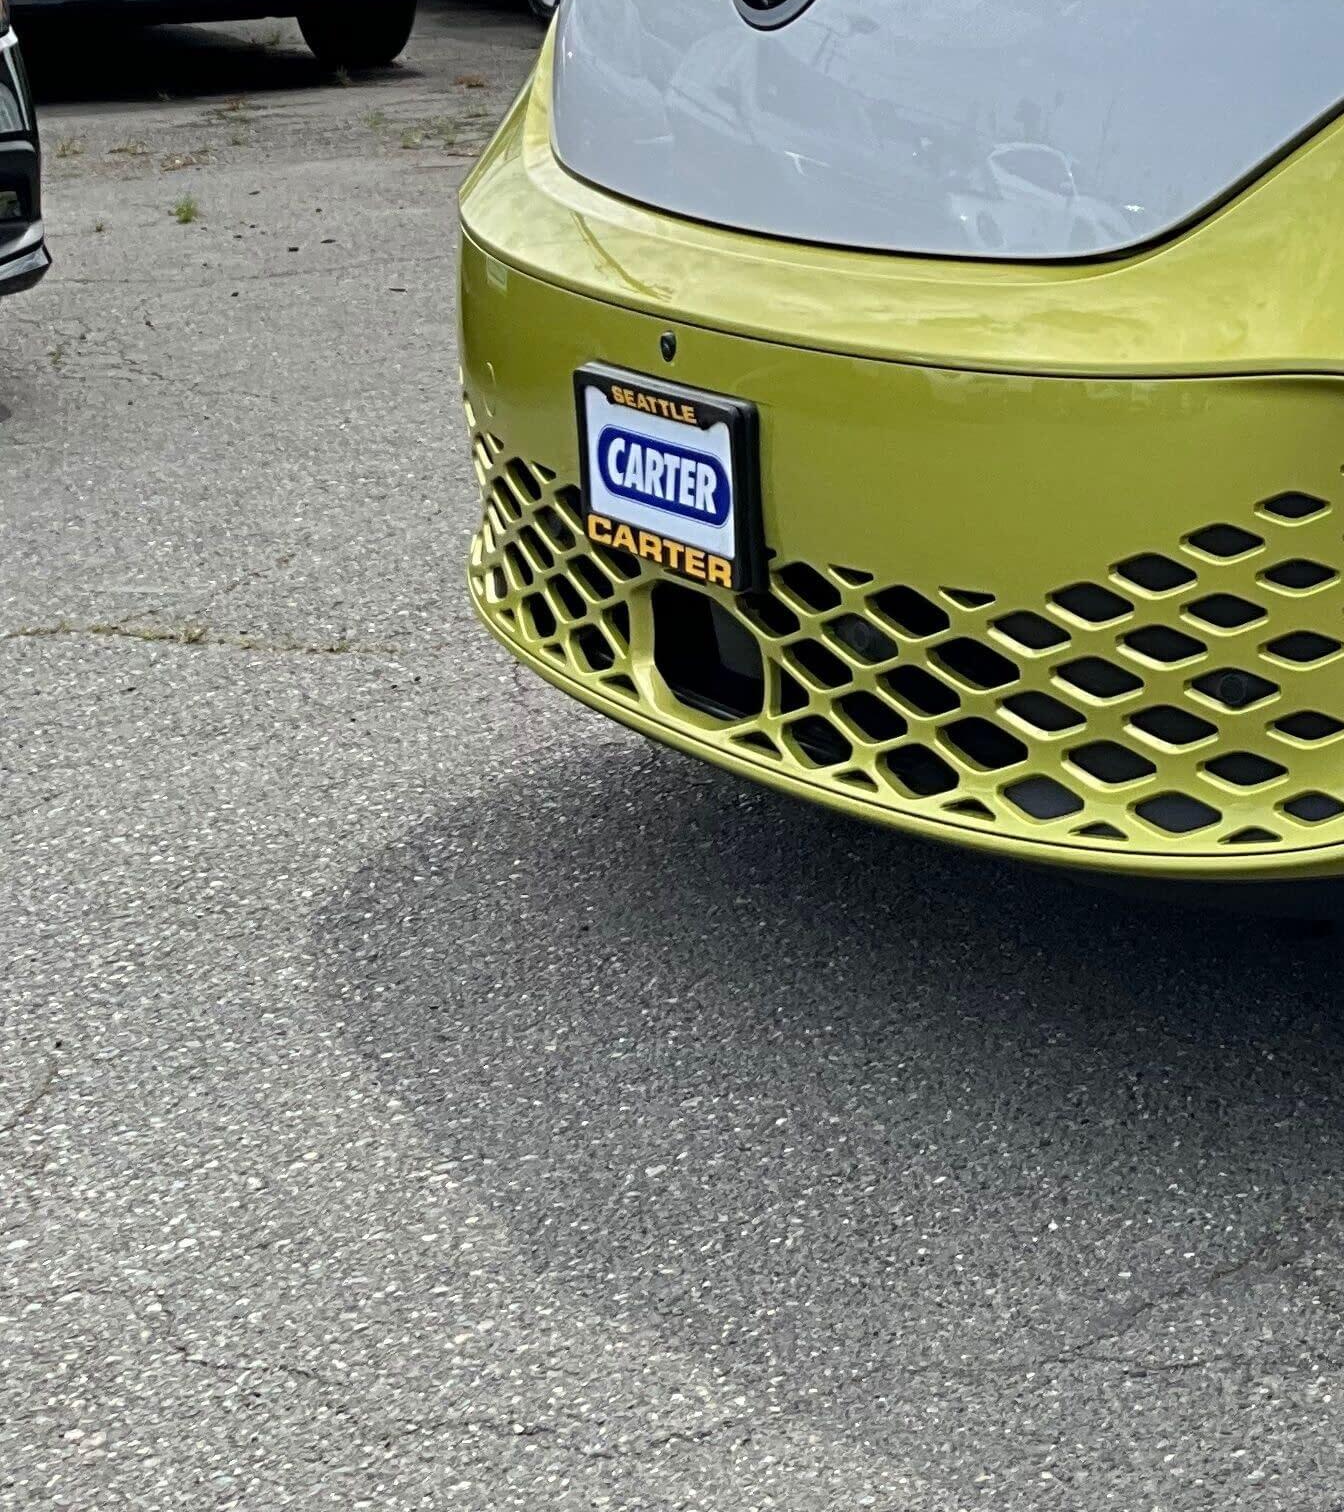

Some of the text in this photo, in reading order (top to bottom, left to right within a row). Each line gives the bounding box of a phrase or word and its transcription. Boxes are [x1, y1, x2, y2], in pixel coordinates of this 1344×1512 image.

[610, 385, 697, 424] SEATTLE
[606, 436, 718, 514] CARTER
[587, 513, 733, 589] CARTER
